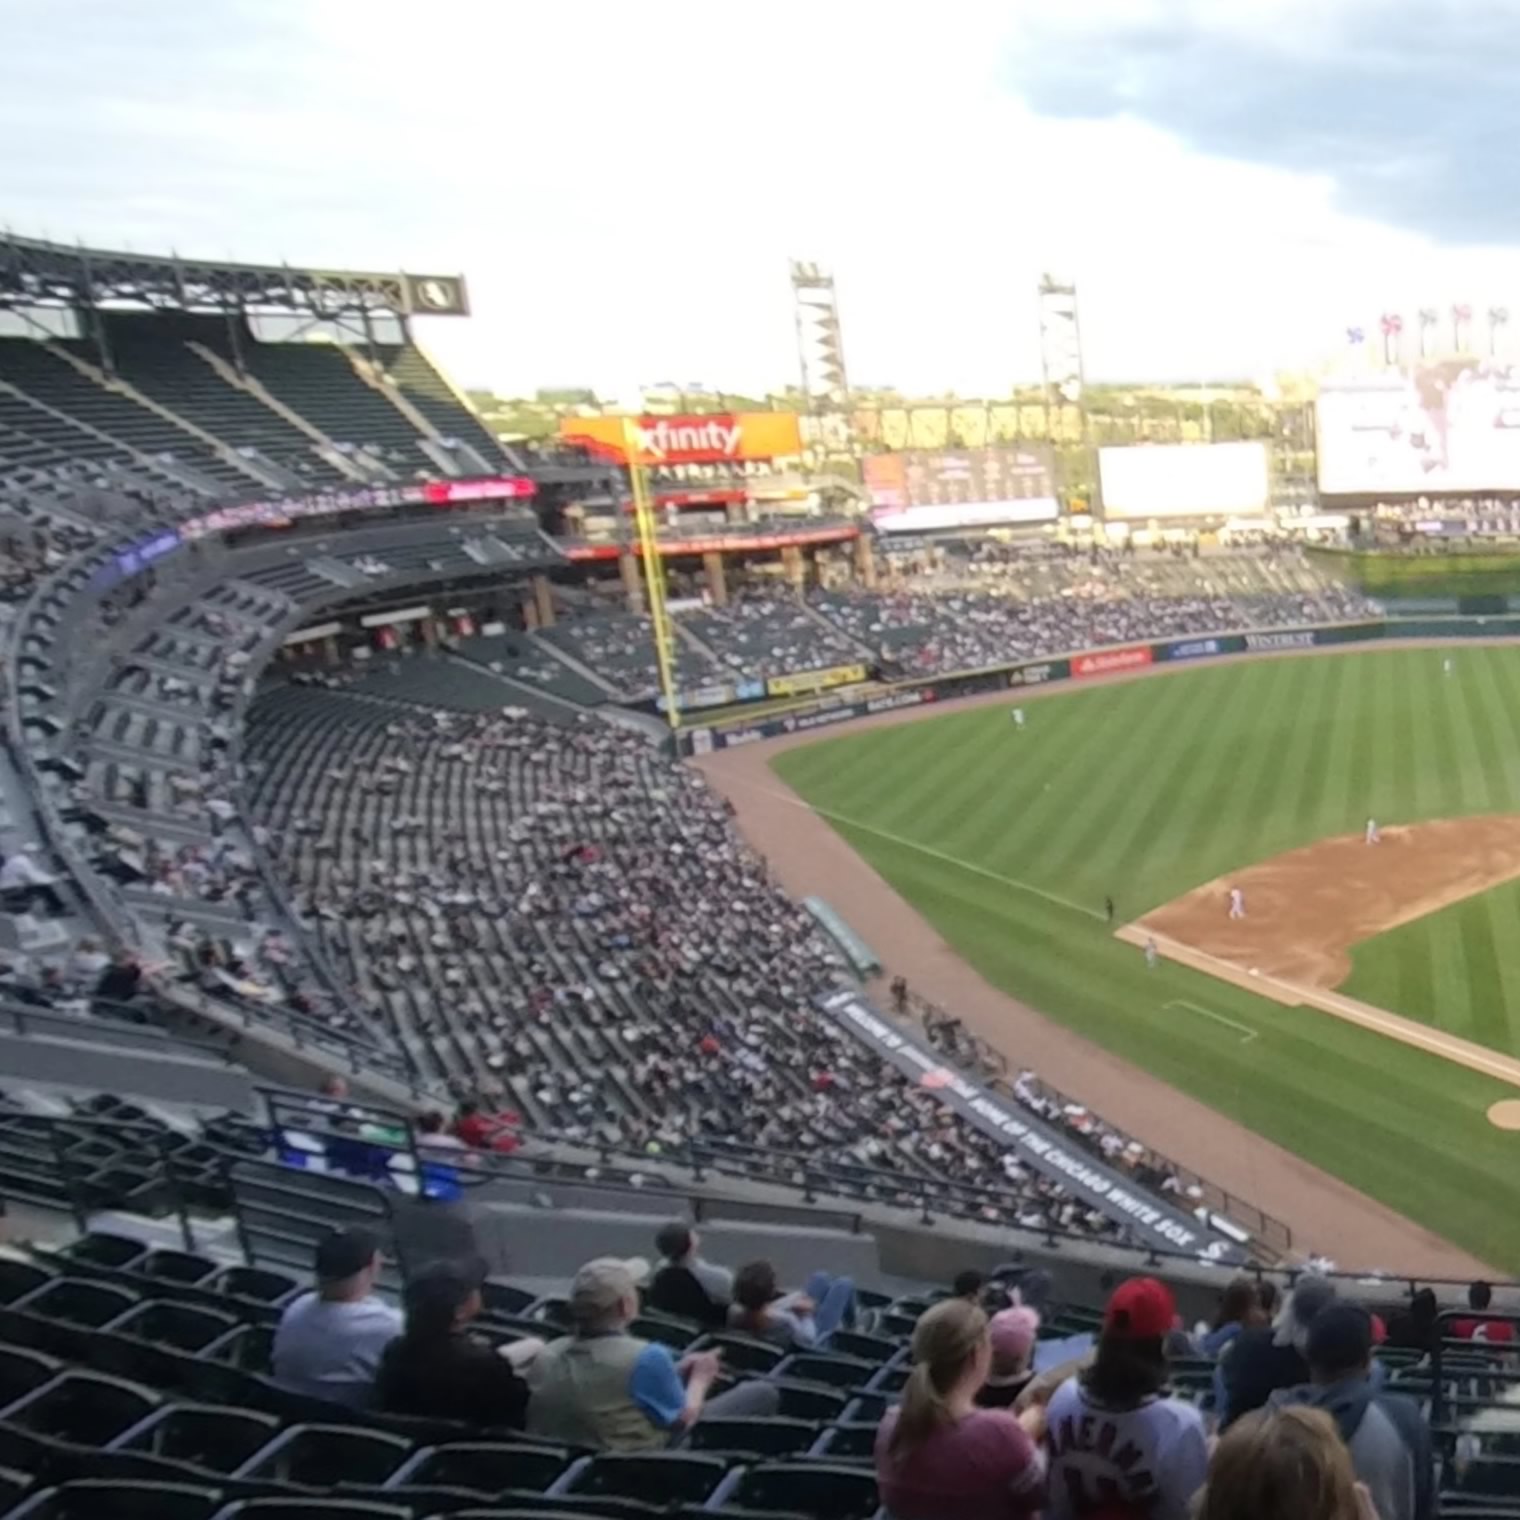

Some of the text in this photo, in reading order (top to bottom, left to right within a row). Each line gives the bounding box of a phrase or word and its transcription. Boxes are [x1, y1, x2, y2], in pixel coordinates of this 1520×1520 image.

[634, 420, 743, 457] xfinity
[1044, 1149, 1112, 1193] CHICAGO
[1105, 1187, 1162, 1225] WHITE
[1153, 1218, 1196, 1247] SOX
